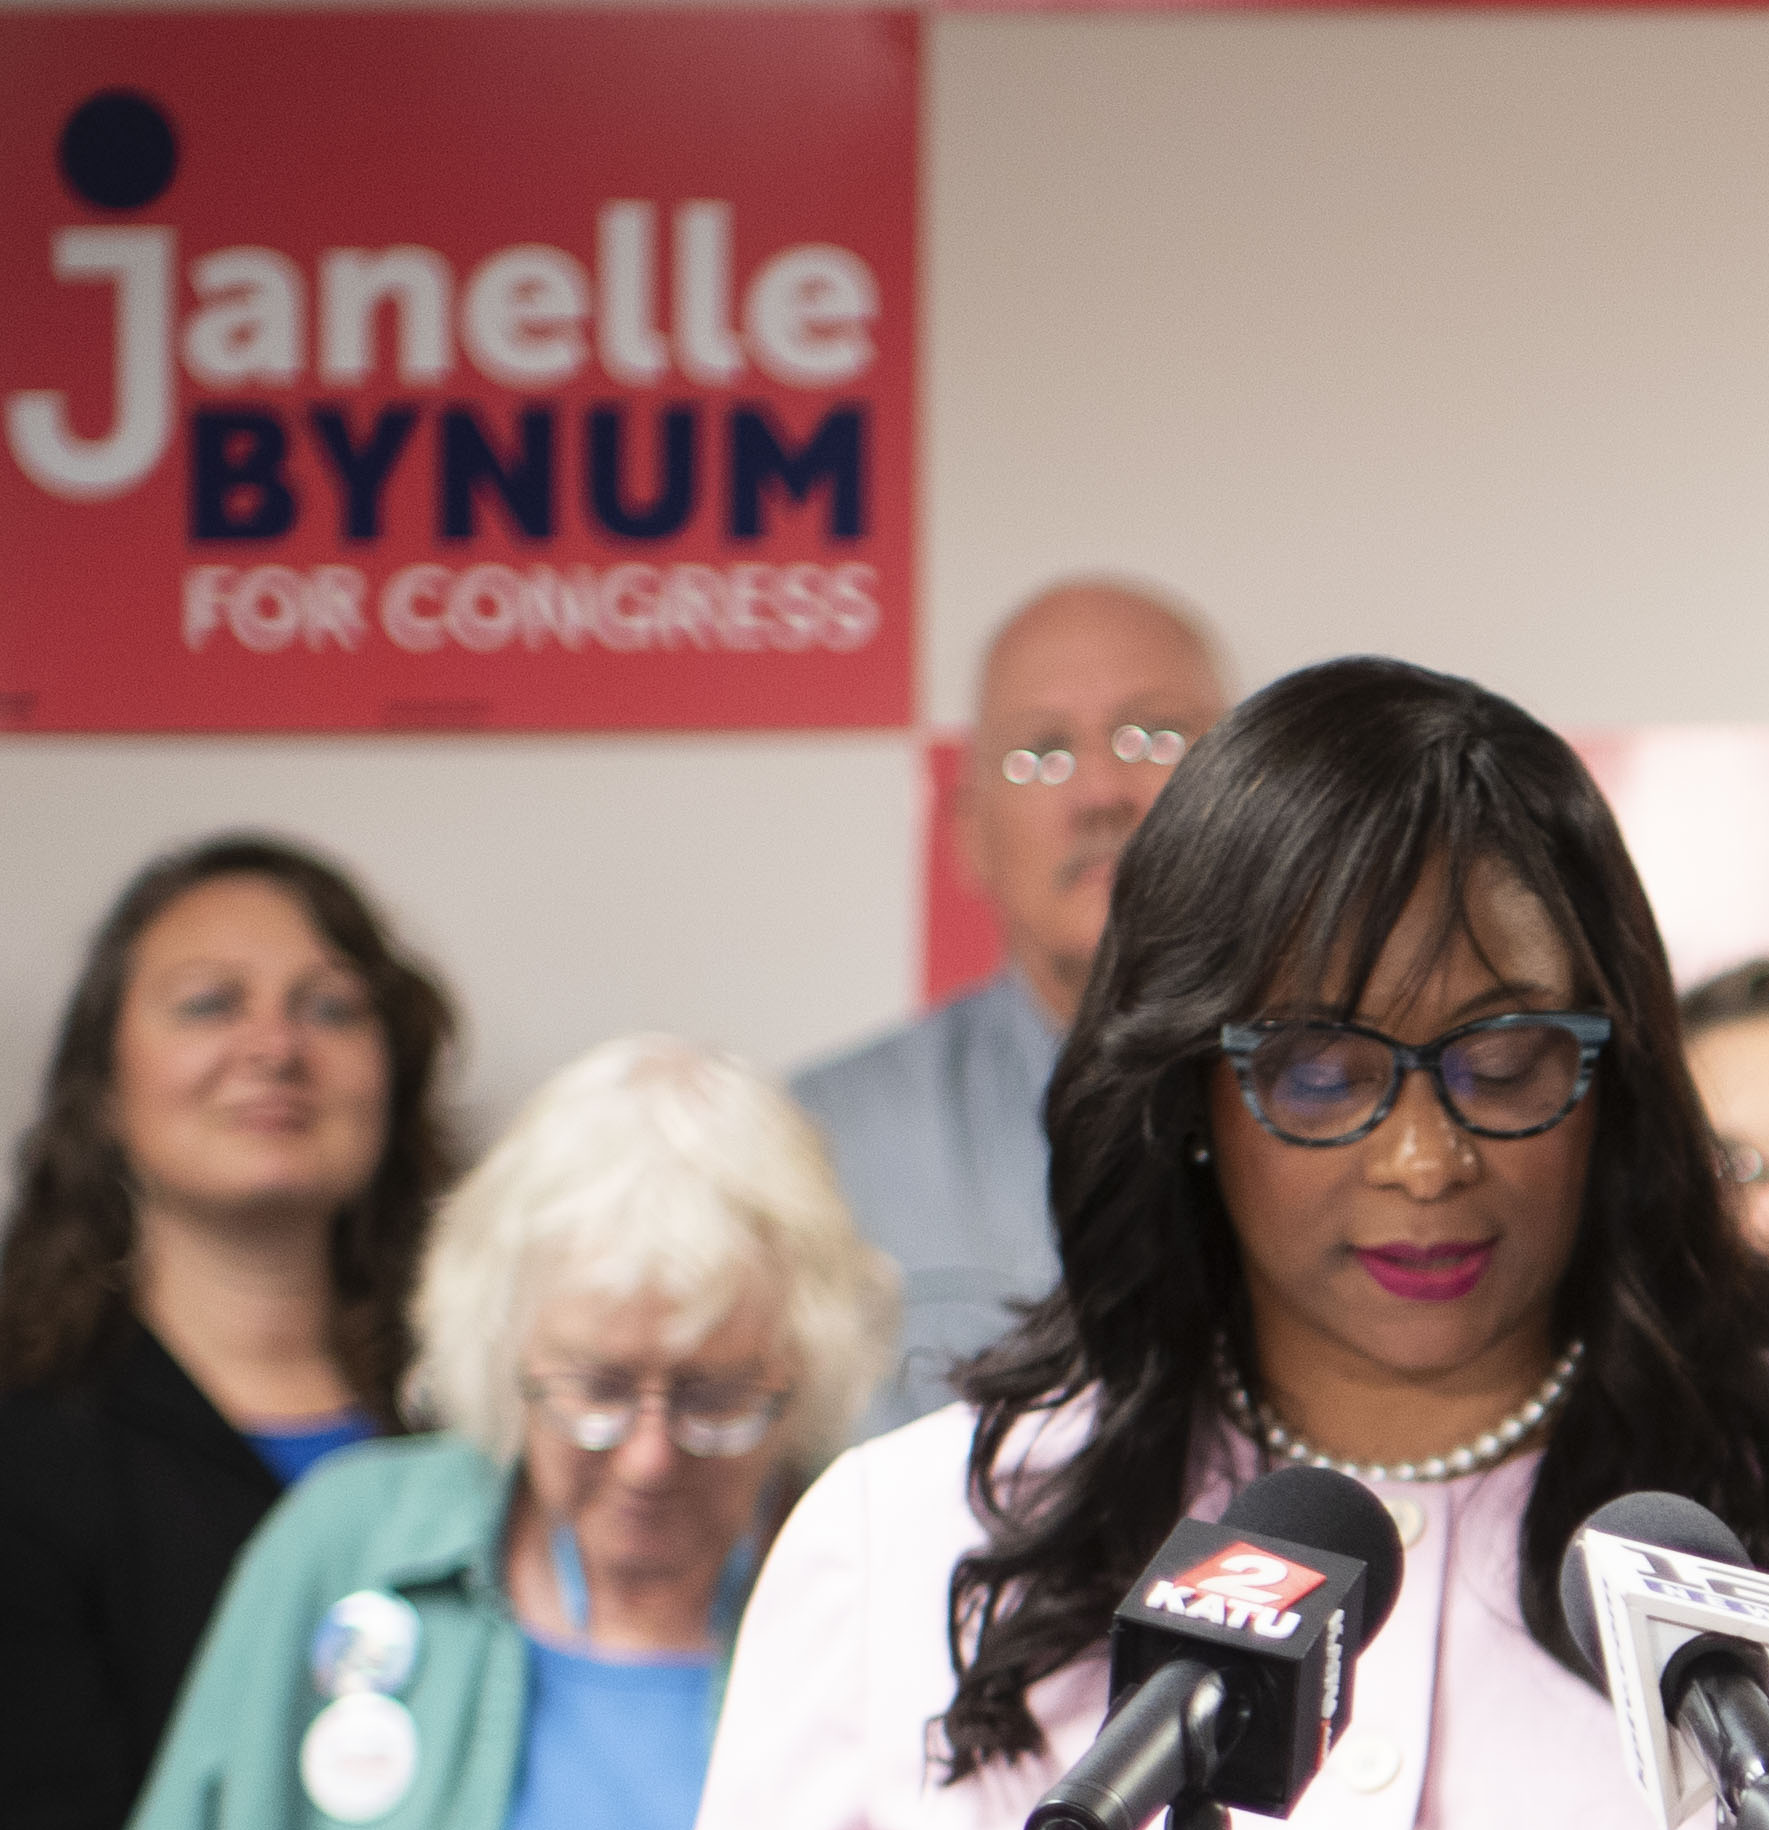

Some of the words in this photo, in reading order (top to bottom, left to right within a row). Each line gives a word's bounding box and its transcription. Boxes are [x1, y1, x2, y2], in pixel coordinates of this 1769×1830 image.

[187, 402, 868, 547] BYNUM
[185, 563, 365, 654] FOR
[381, 562, 881, 654] CONGRESS
[1145, 1580, 1302, 1639] KATU
[1197, 1553, 1289, 1603] 2
